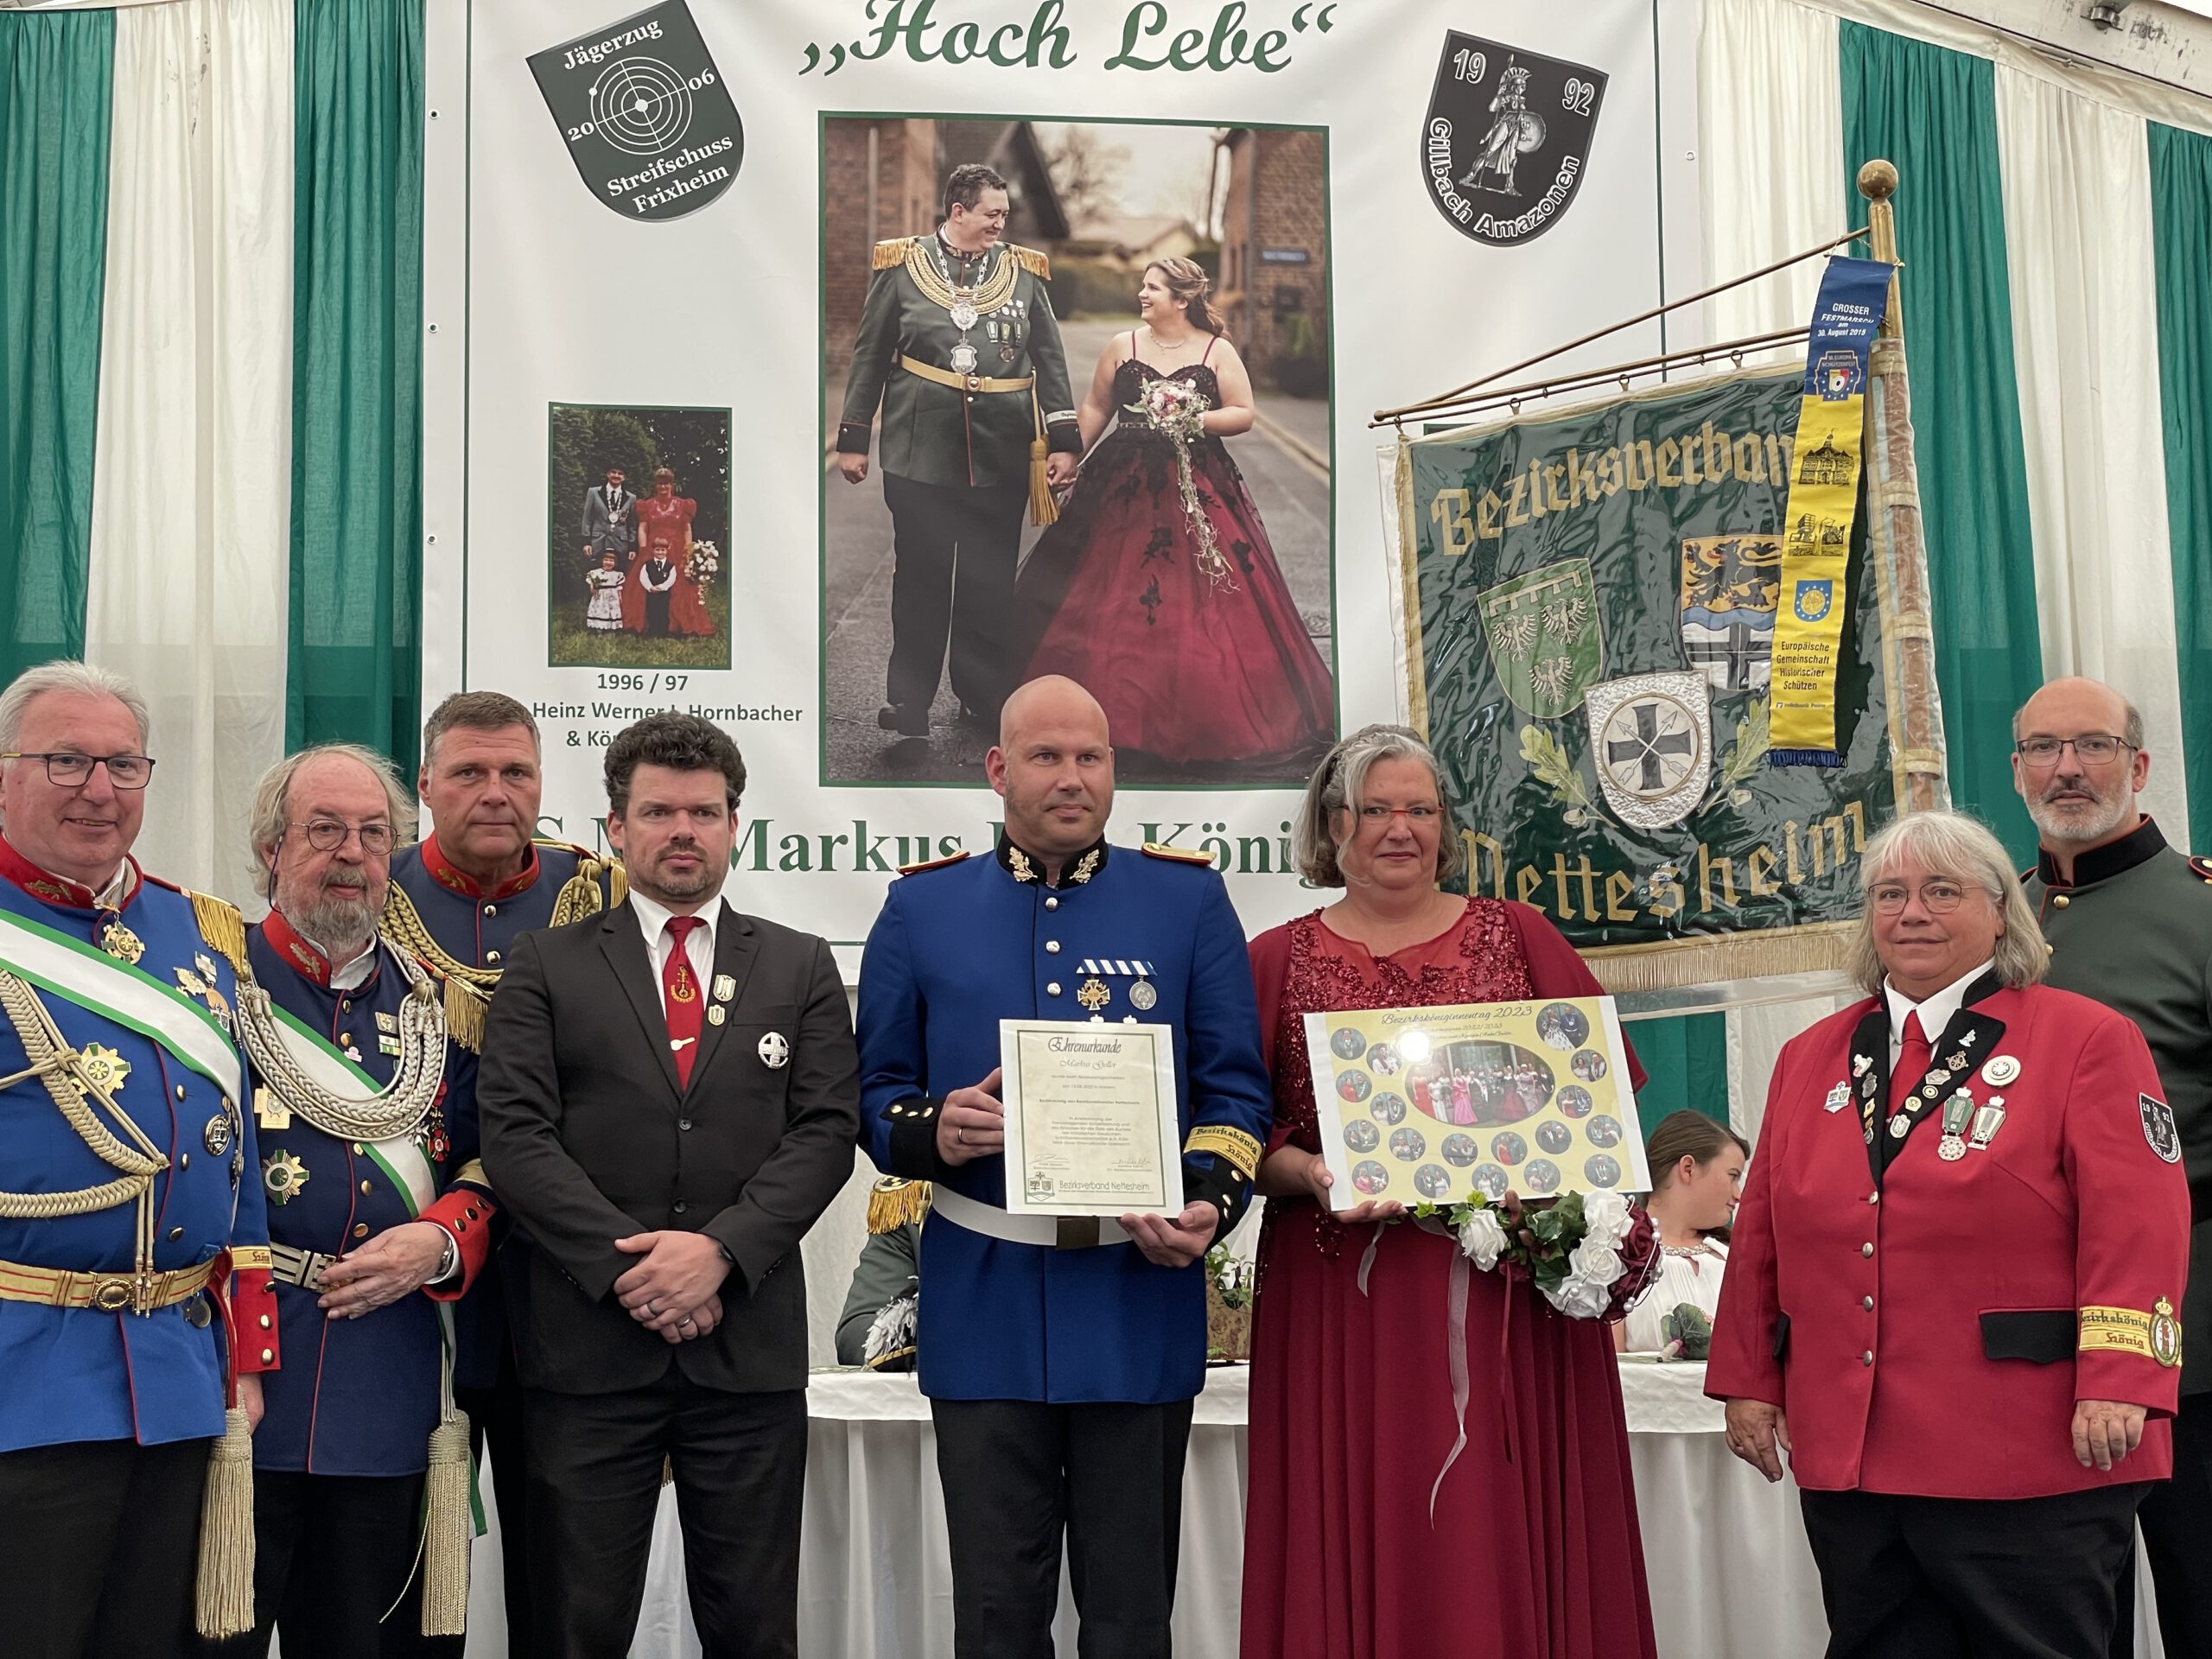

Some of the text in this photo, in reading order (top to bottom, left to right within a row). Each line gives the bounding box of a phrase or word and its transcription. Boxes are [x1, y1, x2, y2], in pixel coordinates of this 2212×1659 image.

[563, 20, 664, 70] Jägerzug
[1453, 48, 1487, 84] 19
[688, 68, 715, 91] 06
[1562, 78, 1596, 117] 92
[568, 121, 594, 142] 20
[607, 136, 734, 197] Streifschuss
[1428, 117, 1580, 238] Gillbach Amazonen
[632, 165, 730, 213] Frixheim
[1832, 302, 1870, 316] GROSSER
[1827, 328, 1849, 338] August
[1431, 420, 1795, 556] Bezirksverban
[1781, 641, 1830, 652] Europäische
[1777, 654, 1830, 664] Gemeinschaft
[1779, 667, 1826, 677] Historischer
[597, 673, 644, 690] 1996
[664, 675, 689, 690] 97
[1783, 680, 1818, 690] Schützen
[533, 702, 585, 718] Heinz
[689, 703, 803, 721] Hornbacher
[566, 730, 582, 747] &
[1493, 1006, 1533, 1019] 2023
[1048, 1036, 1122, 1053] Ehrenurkunde
[1059, 1179, 1110, 1191] Bezirksverband
